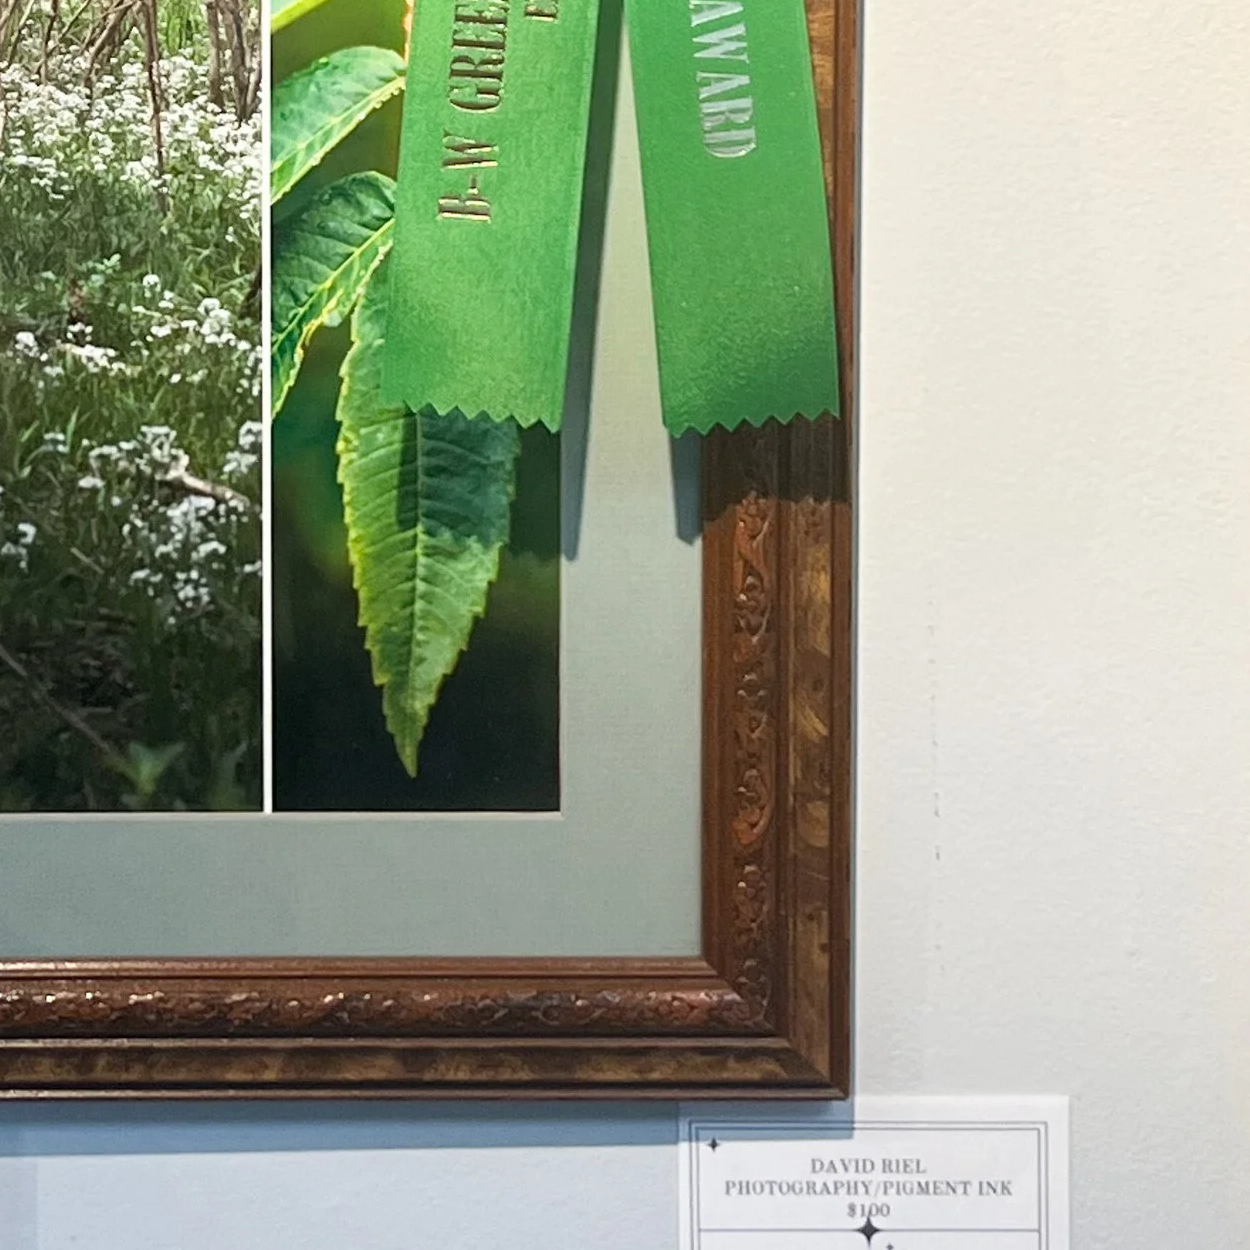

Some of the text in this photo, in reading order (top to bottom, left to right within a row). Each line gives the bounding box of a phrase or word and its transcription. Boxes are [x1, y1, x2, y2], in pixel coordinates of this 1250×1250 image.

[437, 130, 500, 224] B-W
[810, 1158, 927, 1174] DAVID RIEL
[724, 1180, 1014, 1196] PHOTOGRAPHY/PIGMENT INK
[847, 1203, 891, 1217] $100
